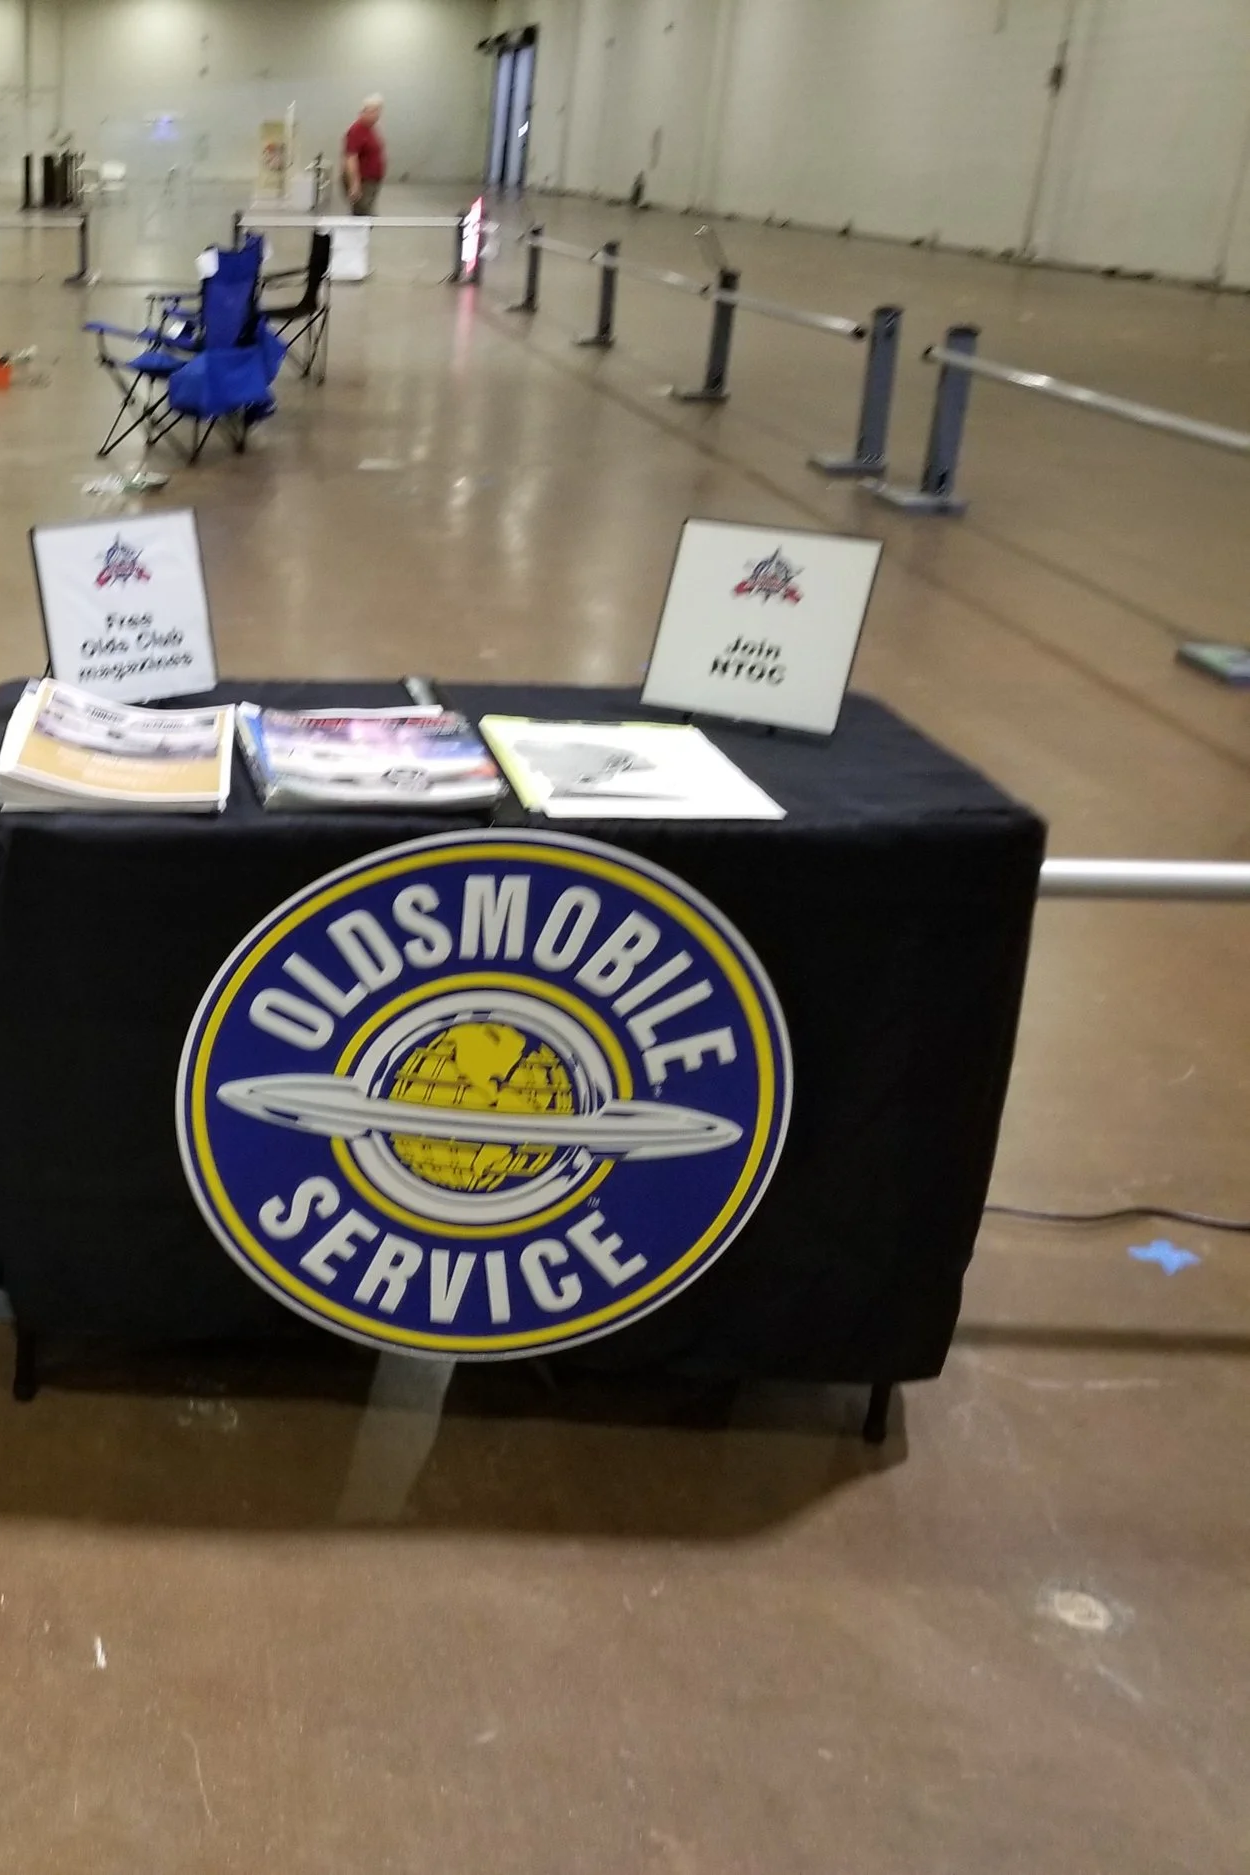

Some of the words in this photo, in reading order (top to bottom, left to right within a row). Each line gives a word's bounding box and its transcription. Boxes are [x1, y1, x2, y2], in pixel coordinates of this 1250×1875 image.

[105, 612, 153, 632] Free
[136, 627, 184, 652] Club
[726, 636, 782, 659] Join
[710, 655, 787, 685] NTOC
[249, 873, 739, 1088] OLDSMOBILE
[257, 1175, 649, 1325] SERVICE
